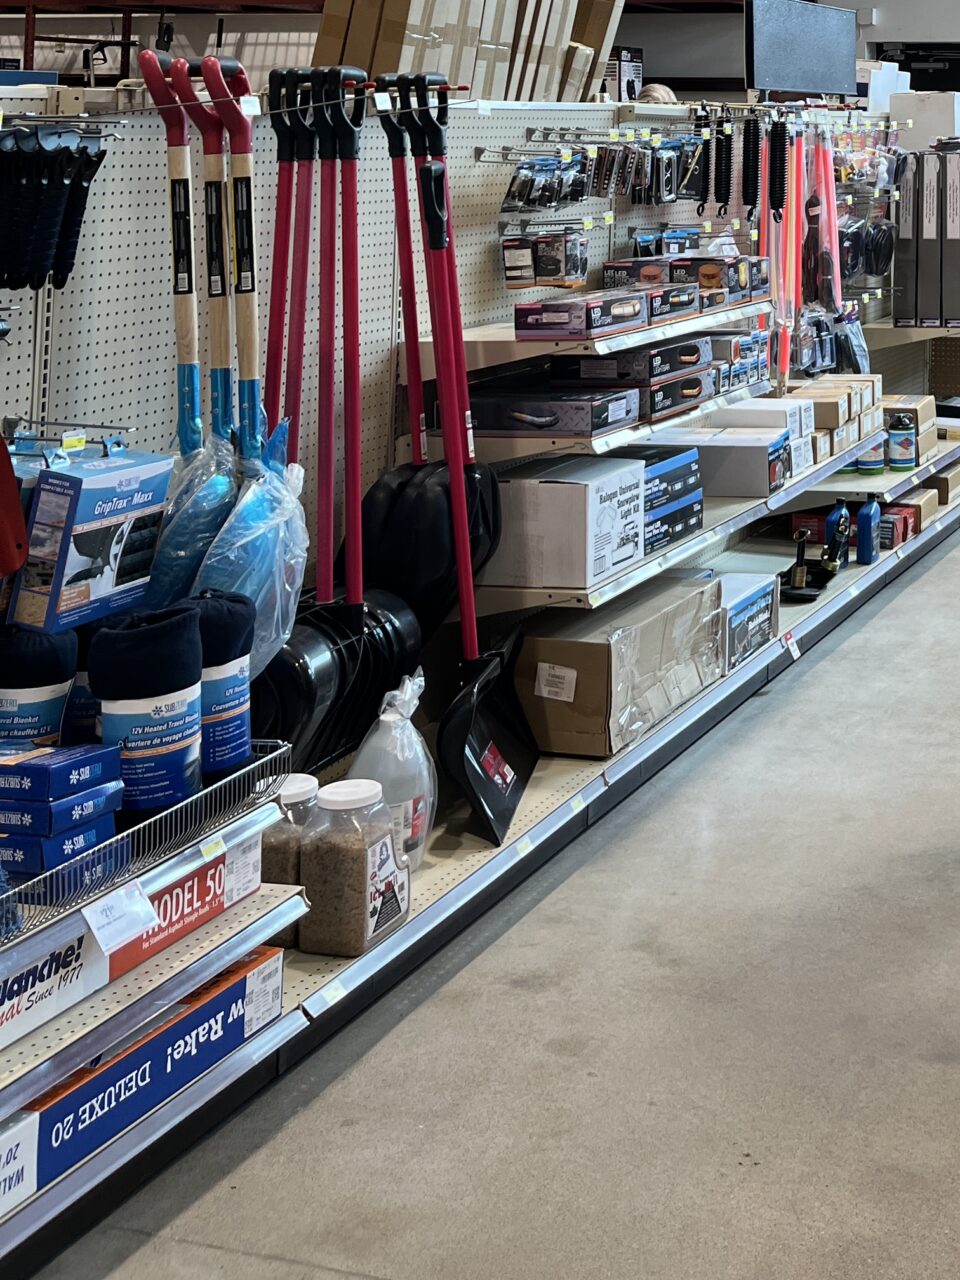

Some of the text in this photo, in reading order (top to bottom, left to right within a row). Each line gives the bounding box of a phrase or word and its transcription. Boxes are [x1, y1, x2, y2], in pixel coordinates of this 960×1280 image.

[618, 479, 640, 496] Universal
[94, 490, 154, 516] GripTrax Maxx
[620, 506, 632, 520] Light
[13, 715, 39, 724] Blanket
[131, 726, 143, 735] 12V
[143, 722, 167, 733] Heated
[168, 718, 184, 729] Travel
[162, 730, 182, 743] voyage
[205, 863, 226, 902] 50
[149, 931, 168, 946] Standard
[0, 935, 84, 1007] lanche!
[25, 984, 54, 1011] Since
[57, 962, 84, 991] 1977
[166, 1014, 225, 1073] Rake!
[51, 1060, 152, 1149] DELUXE 20
[0, 1165, 24, 1196] WAL
